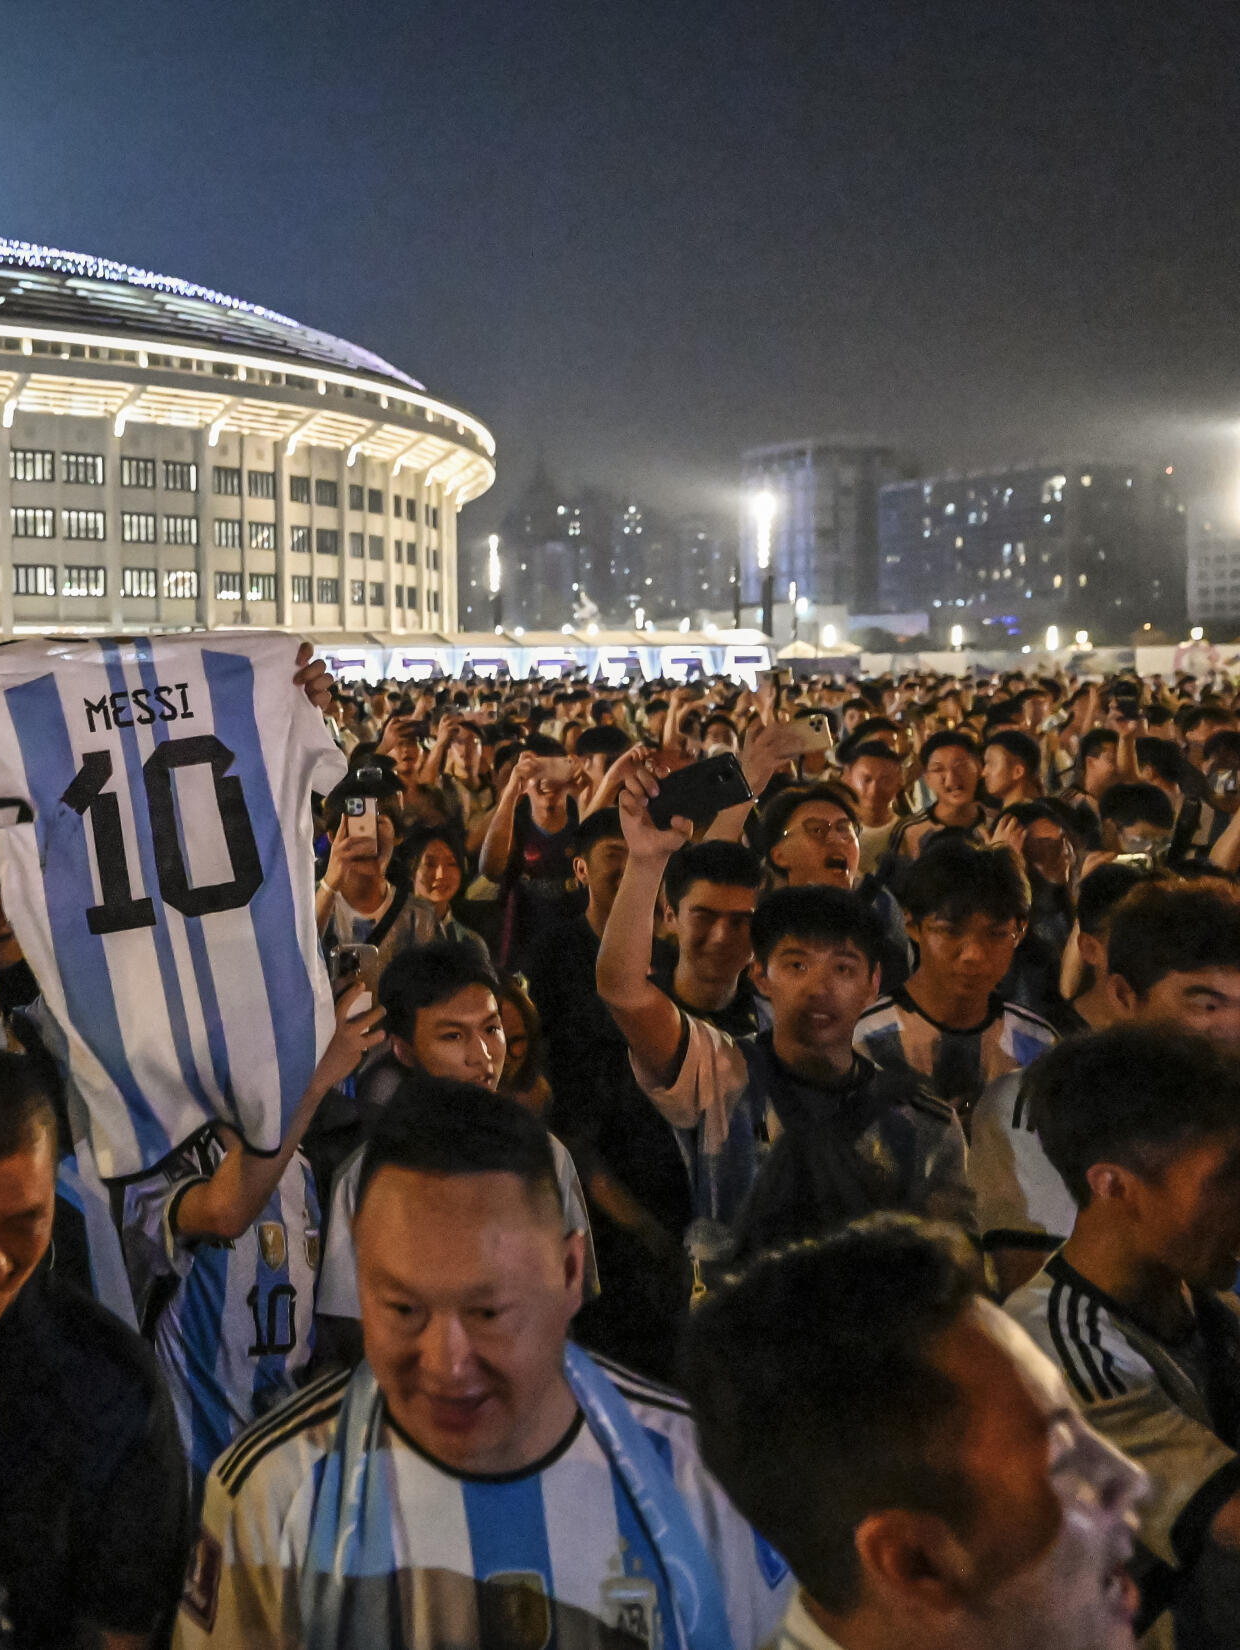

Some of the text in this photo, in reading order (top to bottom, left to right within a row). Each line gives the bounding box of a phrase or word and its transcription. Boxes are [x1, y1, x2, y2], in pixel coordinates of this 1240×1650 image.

[83, 683, 195, 733] MESSI
[62, 735, 264, 935] 10
[247, 1284, 297, 1357] 10
